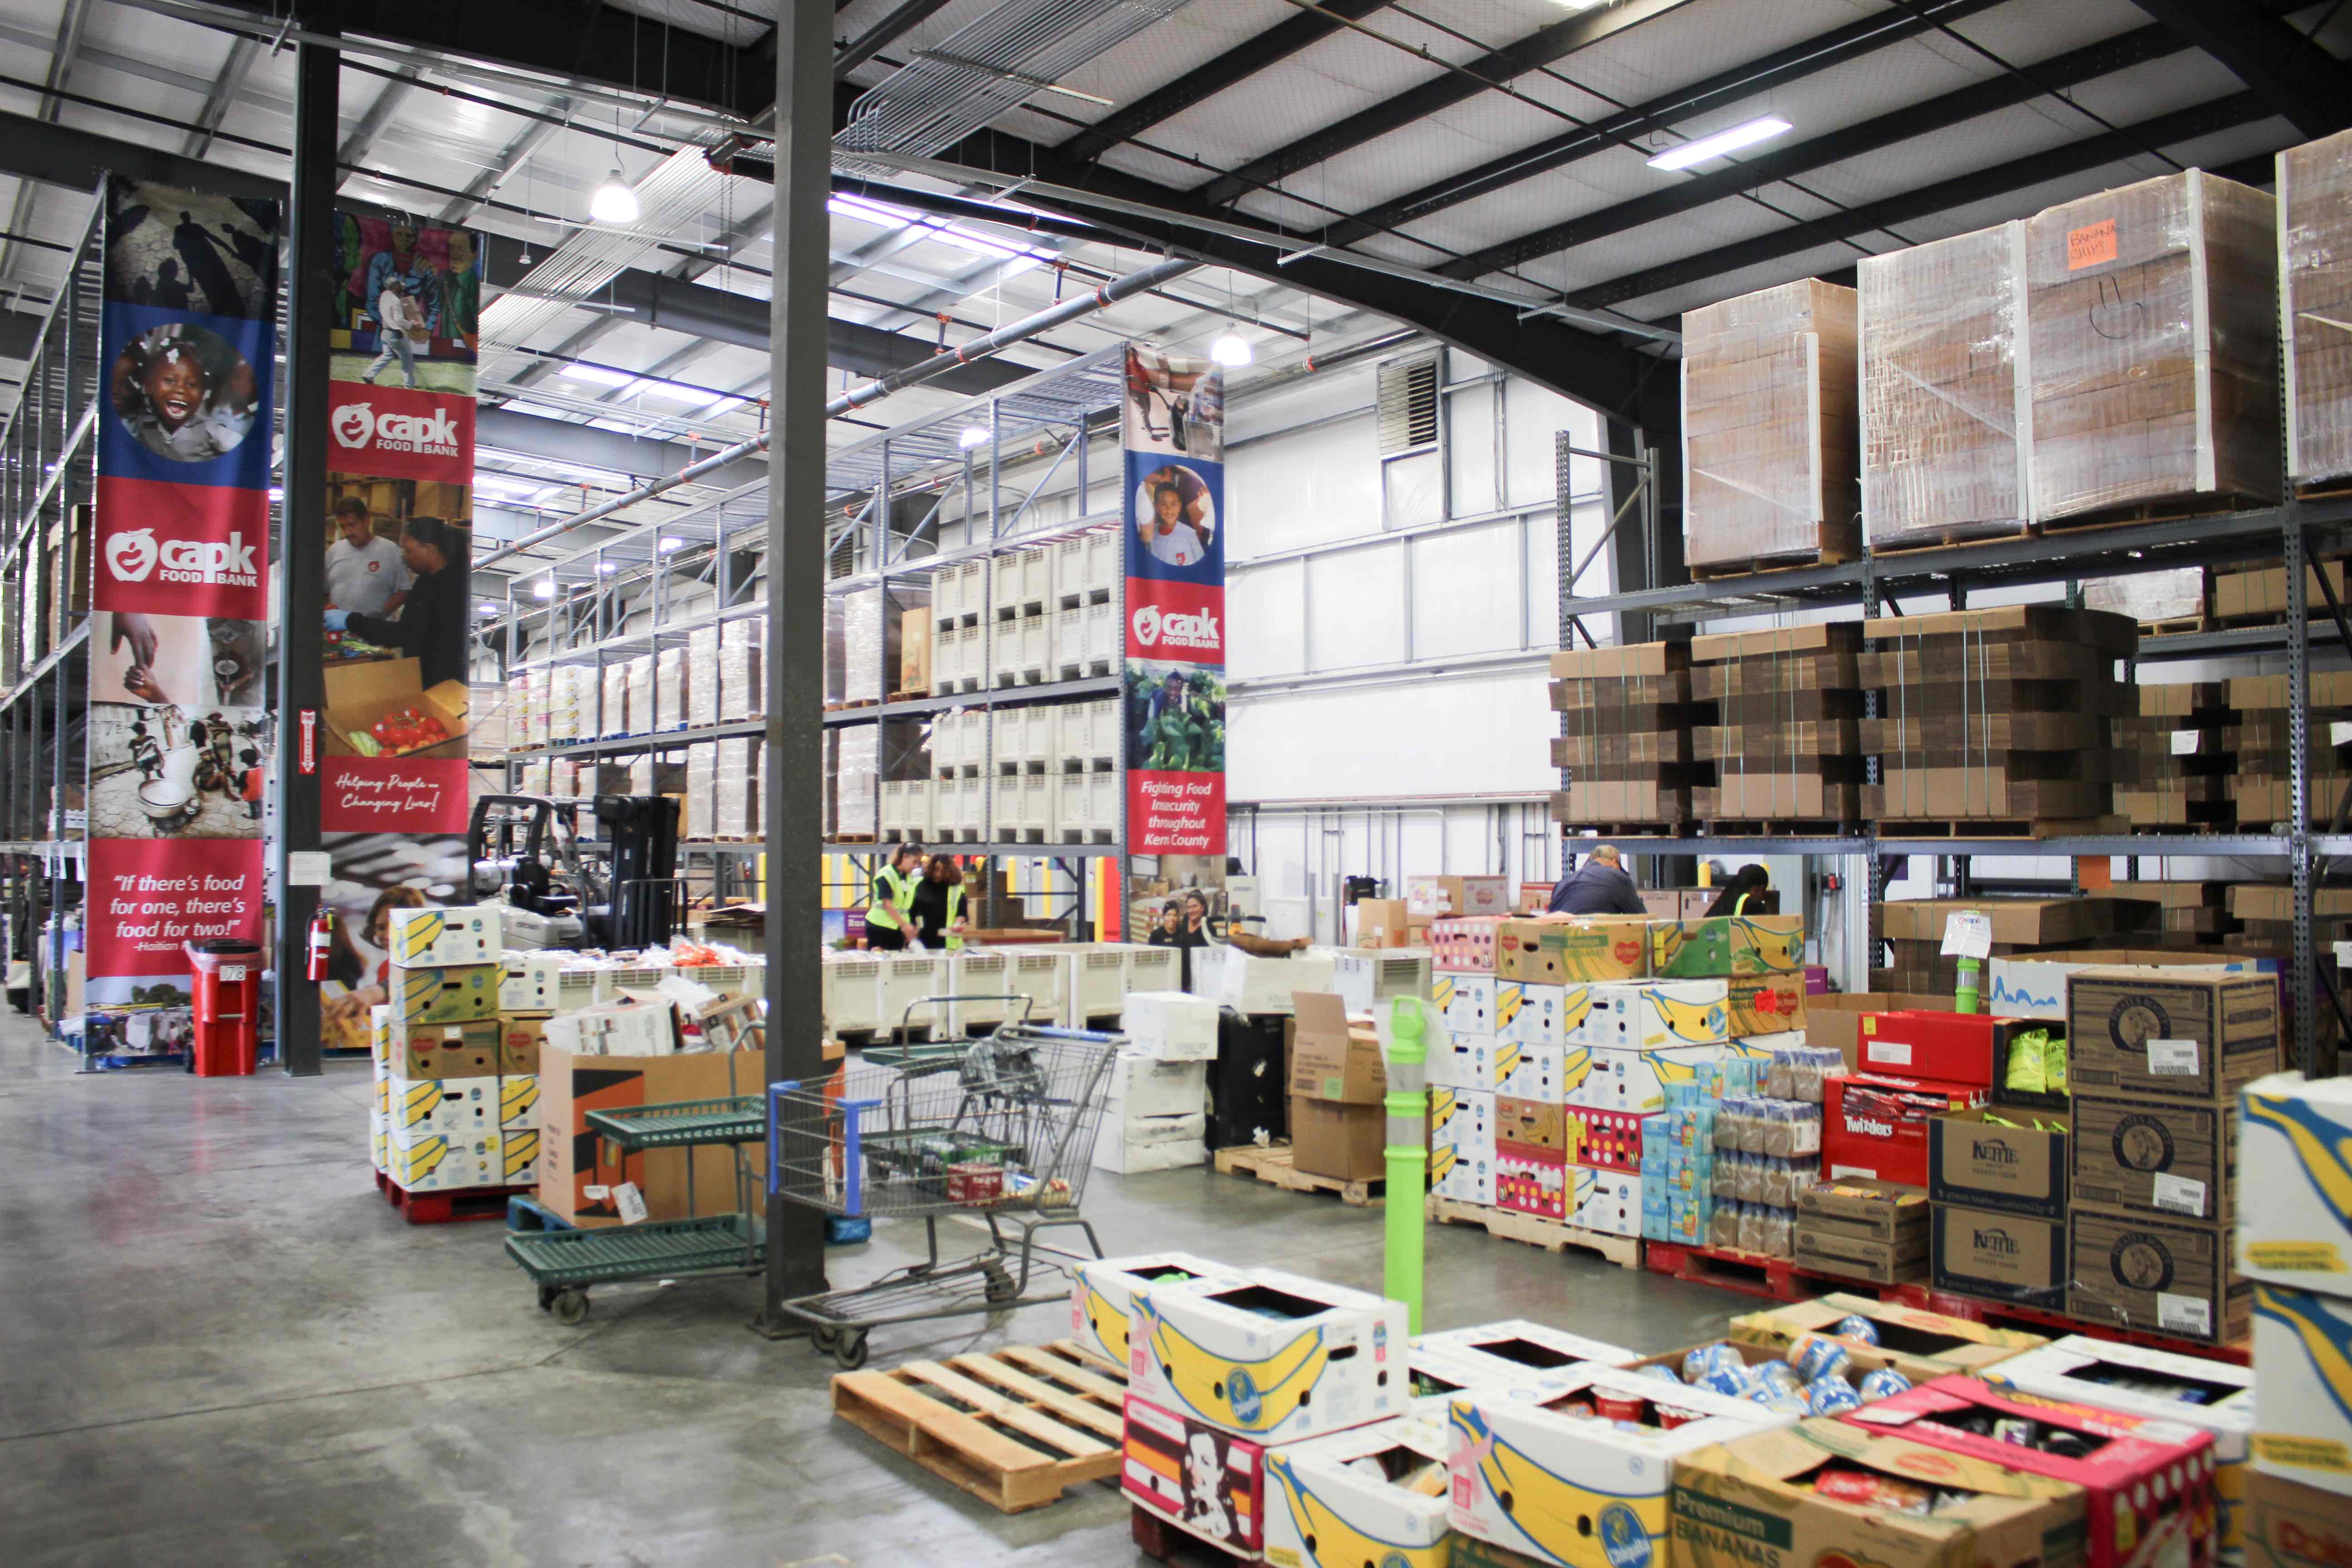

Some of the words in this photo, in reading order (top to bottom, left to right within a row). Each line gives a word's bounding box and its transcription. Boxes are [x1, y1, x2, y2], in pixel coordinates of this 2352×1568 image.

[2069, 224, 2116, 247] BANANA
[377, 408, 458, 453] capk
[377, 439, 412, 451] FOOD
[424, 444, 458, 457] BANK
[159, 531, 258, 583] capk
[159, 569, 203, 583] FOOD
[216, 573, 258, 587] BANK
[1162, 607, 1220, 647] capk
[1162, 636, 1189, 646] FOOD
[1195, 638, 1220, 649] BANK
[335, 773, 385, 793] Helping
[387, 774, 427, 791] People
[1141, 781, 1184, 798] Fighting
[1186, 782, 1212, 795] Food
[341, 793, 402, 813] Changing
[1151, 799, 1200, 815] Insecurity
[1148, 815, 1205, 833] throughout
[1144, 833, 1170, 846] Kern
[1171, 834, 1210, 849] County
[137, 875, 200, 892] there's
[203, 874, 246, 891] food
[110, 898, 138, 915] for
[141, 902, 181, 916] one,
[185, 897, 246, 914] there's
[116, 921, 160, 938] food
[163, 921, 189, 937] for
[1844, 1115, 1893, 1137] Twizzlers
[1675, 1490, 1765, 1539] Premium
[1676, 1518, 1781, 1568] BANANAS
